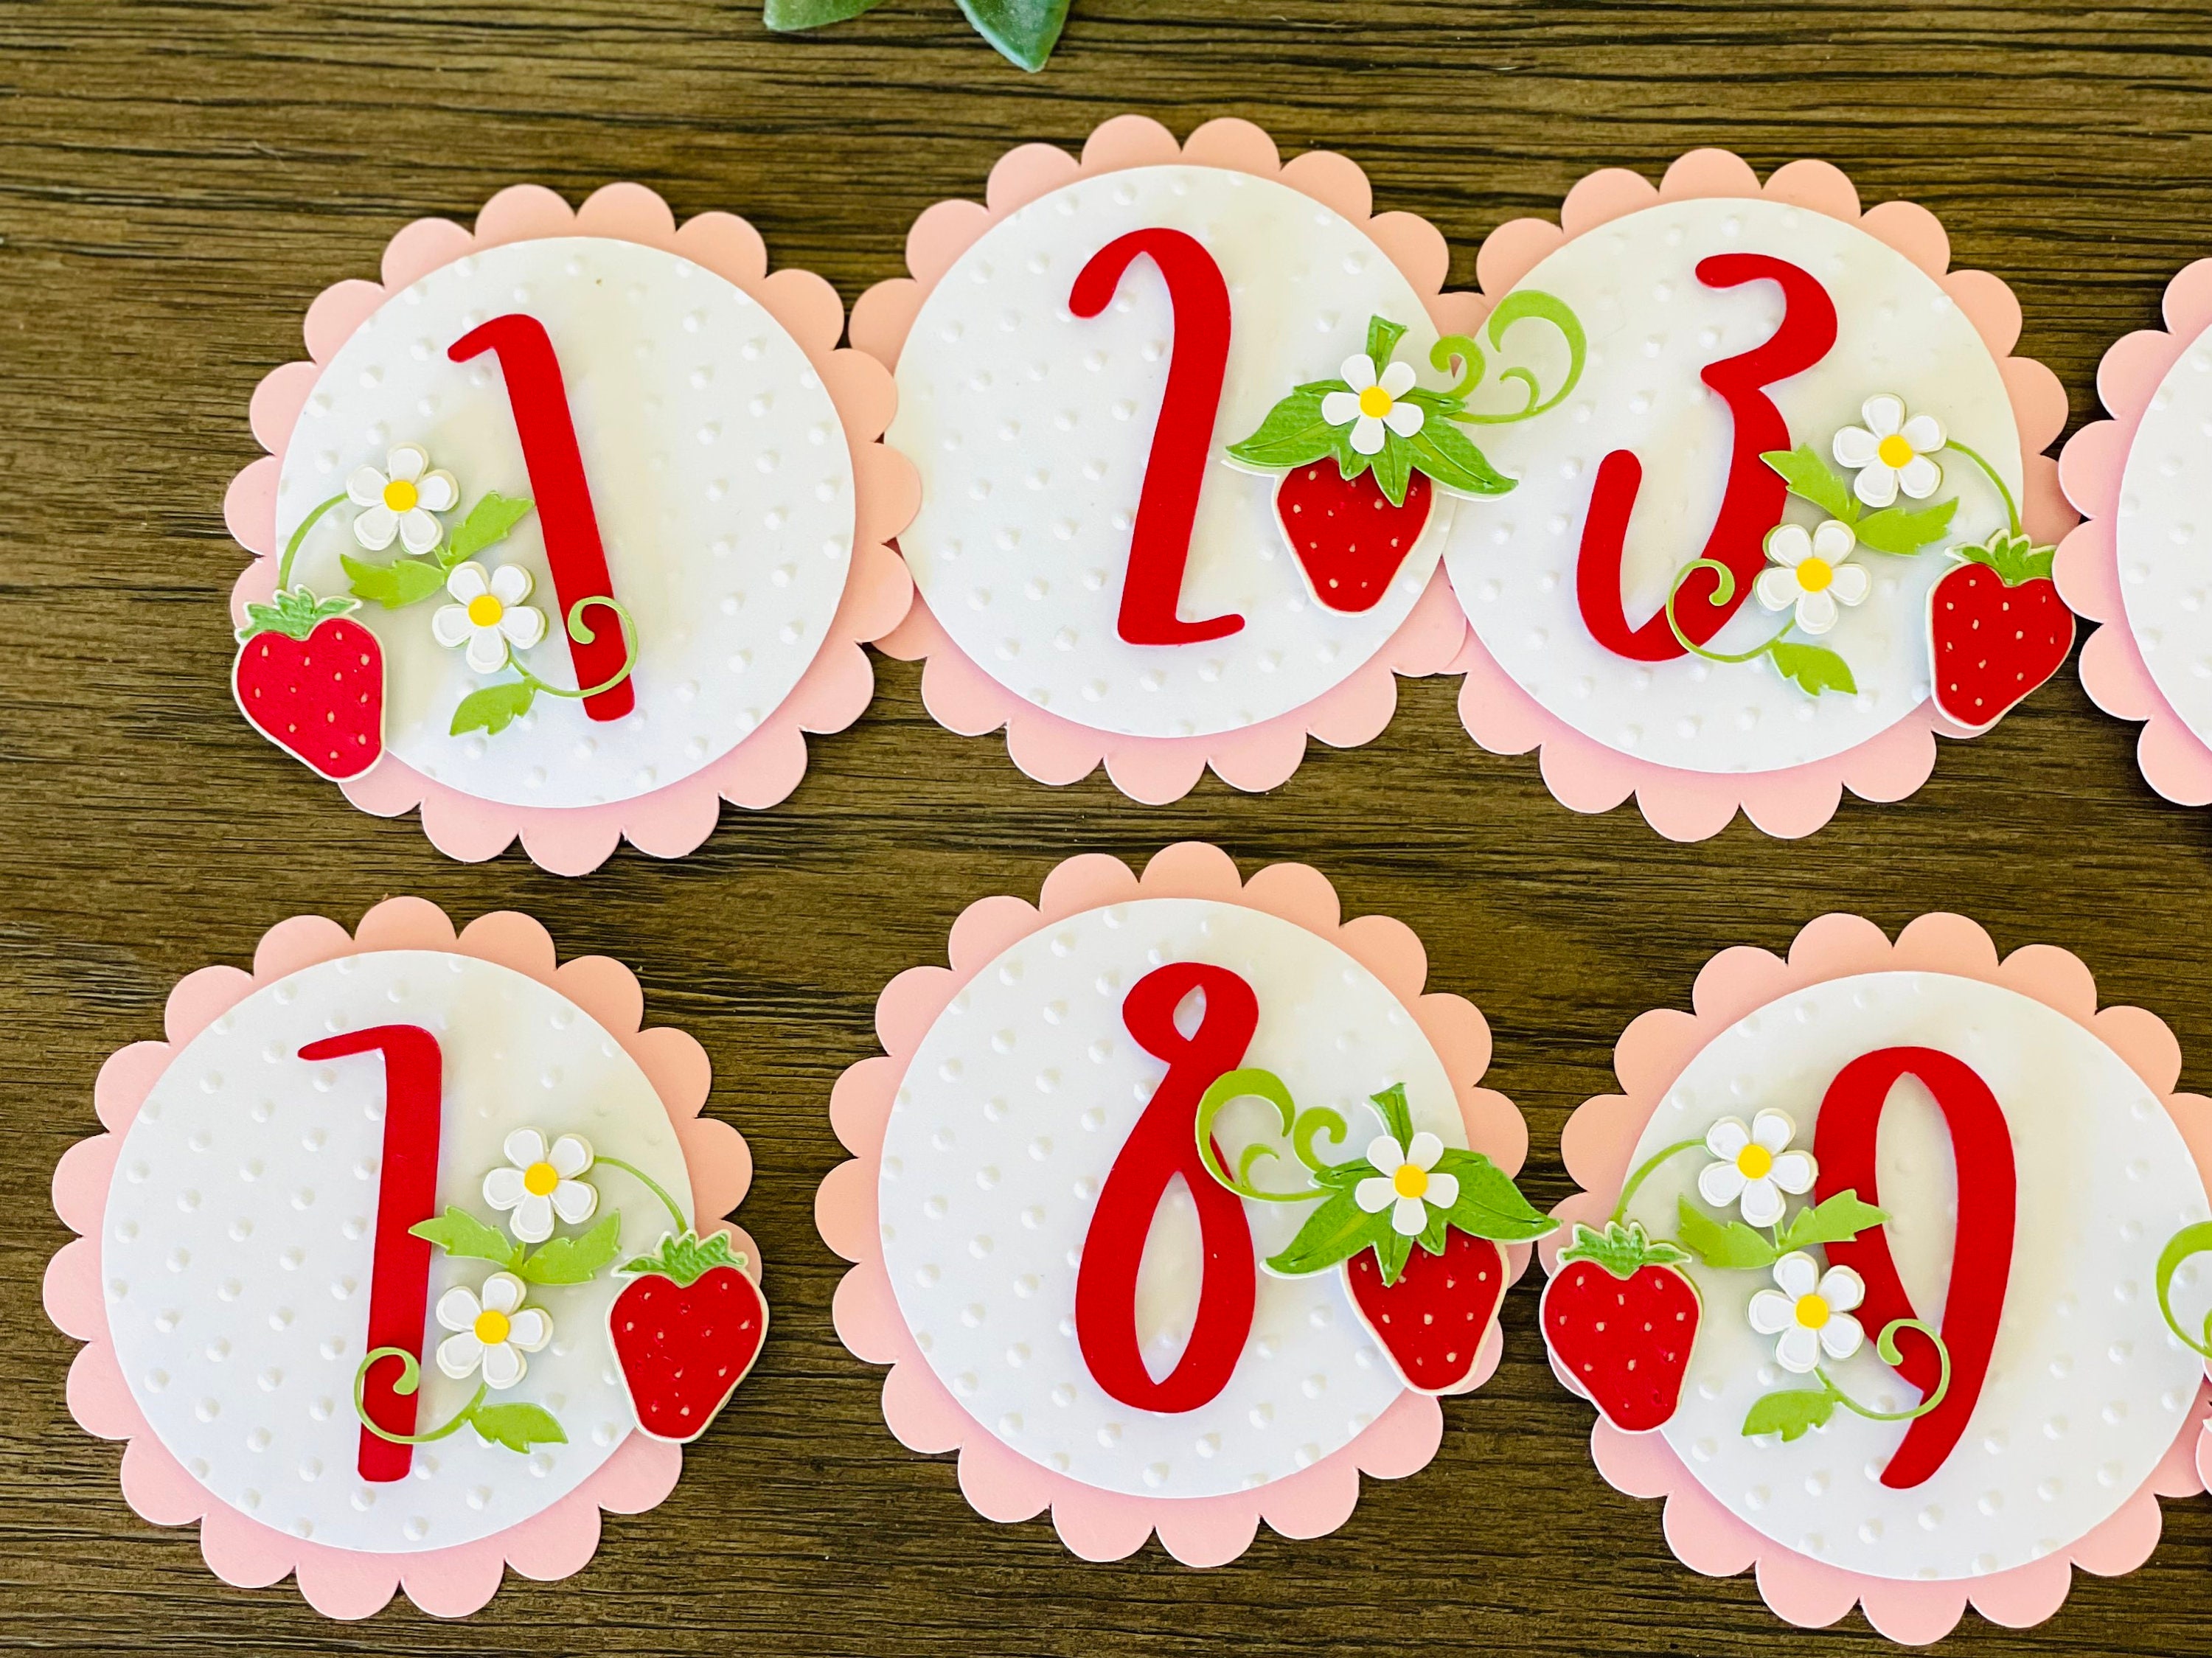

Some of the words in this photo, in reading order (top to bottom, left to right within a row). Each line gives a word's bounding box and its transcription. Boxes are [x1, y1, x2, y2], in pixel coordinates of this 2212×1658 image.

[448, 314, 635, 722] 1
[1068, 228, 1247, 646] 2
[1576, 253, 1837, 662] 3
[1075, 962, 1259, 1413] 8
[1812, 1046, 2017, 1489] 9
